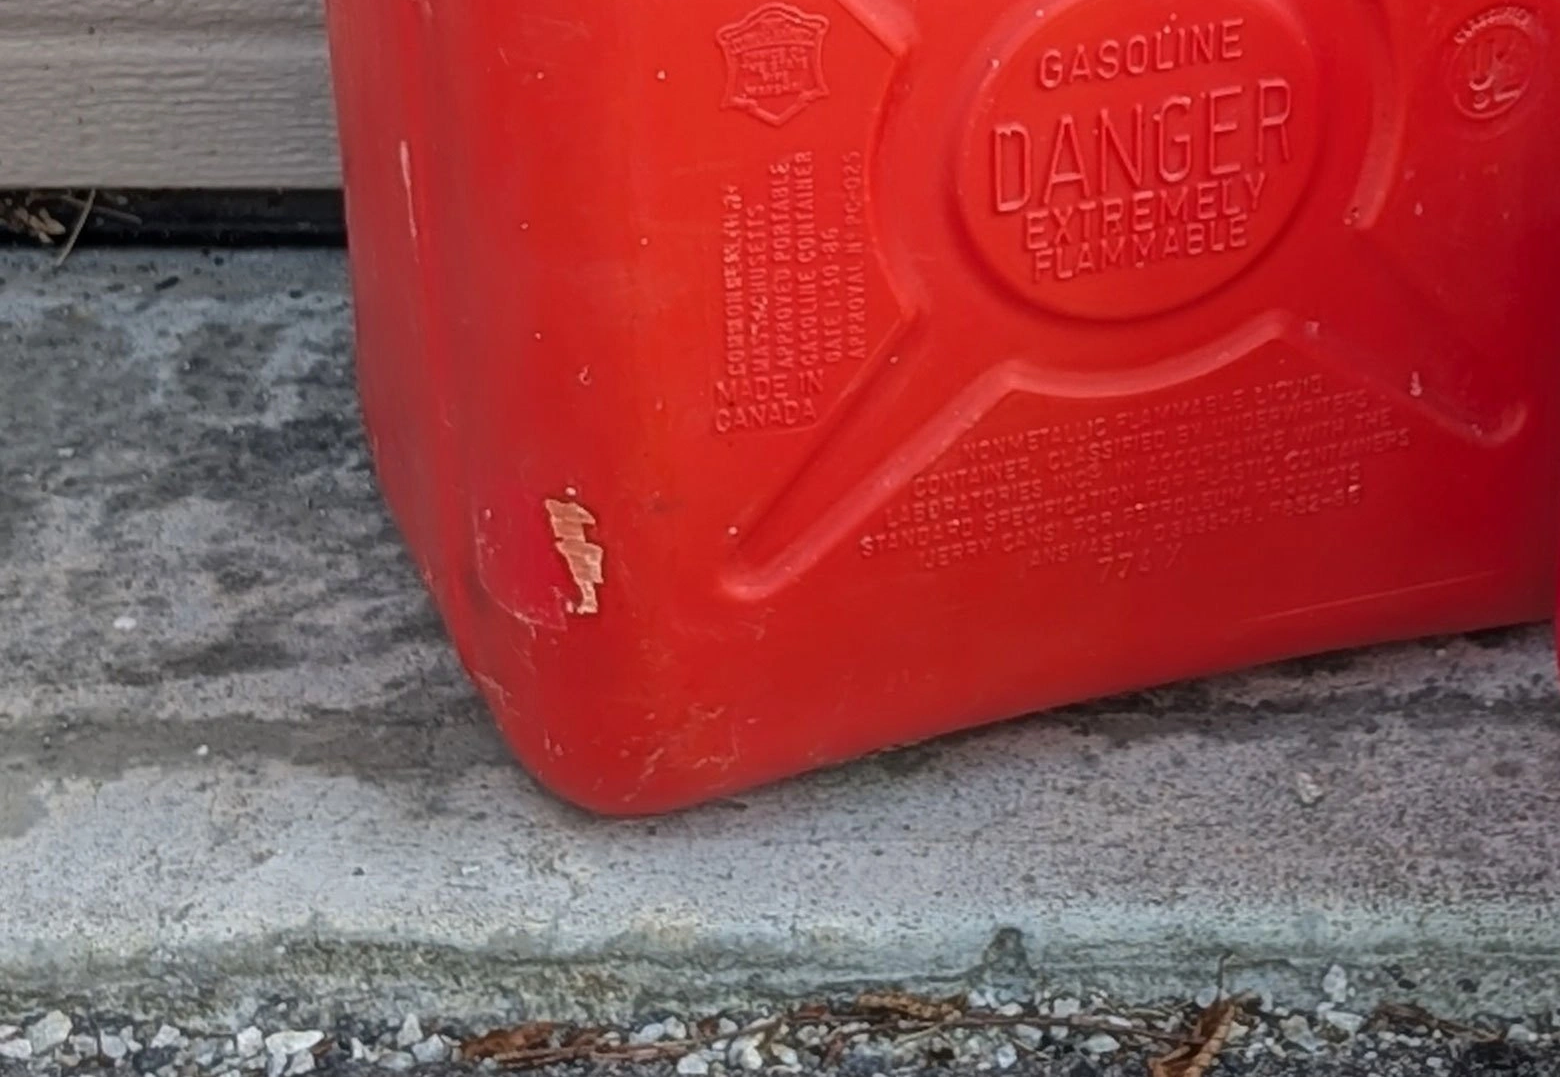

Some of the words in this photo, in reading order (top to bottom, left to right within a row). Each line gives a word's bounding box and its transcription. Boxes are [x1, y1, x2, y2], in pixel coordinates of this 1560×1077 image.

[1040, 18, 1245, 90] GASOLINE
[992, 77, 1293, 214] DANGER
[768, 163, 791, 262] PORTABLE
[794, 150, 816, 264] CONTAINER
[1024, 172, 1266, 251] EXTREMELY
[1034, 215, 1248, 283] FLAMMABLE
[773, 268, 795, 368] APPROVED
[797, 269, 819, 366] GASOLINE
[846, 260, 867, 359] APPROVAL
[713, 373, 788, 403] MADE
[797, 369, 823, 400] IN
[715, 398, 818, 434] CANADA
[962, 414, 1107, 463] NONMETALLIC
[1115, 387, 1245, 432] FLAMMABLE
[1253, 371, 1323, 405] LIQUID
[860, 514, 974, 557] STANDARD
[982, 481, 1137, 533] SPECIFICATION
[1144, 471, 1187, 500] FOR
[1196, 454, 1276, 490] PLASTIC
[1282, 427, 1410, 473] CONTAINERS
[883, 476, 1042, 529] LABORATORIES
[1112, 457, 1138, 483] IN
[1147, 428, 1286, 476] ACCORDANCE
[1294, 416, 1346, 446] WITH
[1353, 406, 1393, 435] THE
[1046, 427, 1167, 471] CLASSIFIED
[1176, 420, 1204, 445] BY
[1072, 510, 1114, 540] FOR
[1121, 484, 1246, 530] PETROLEUM
